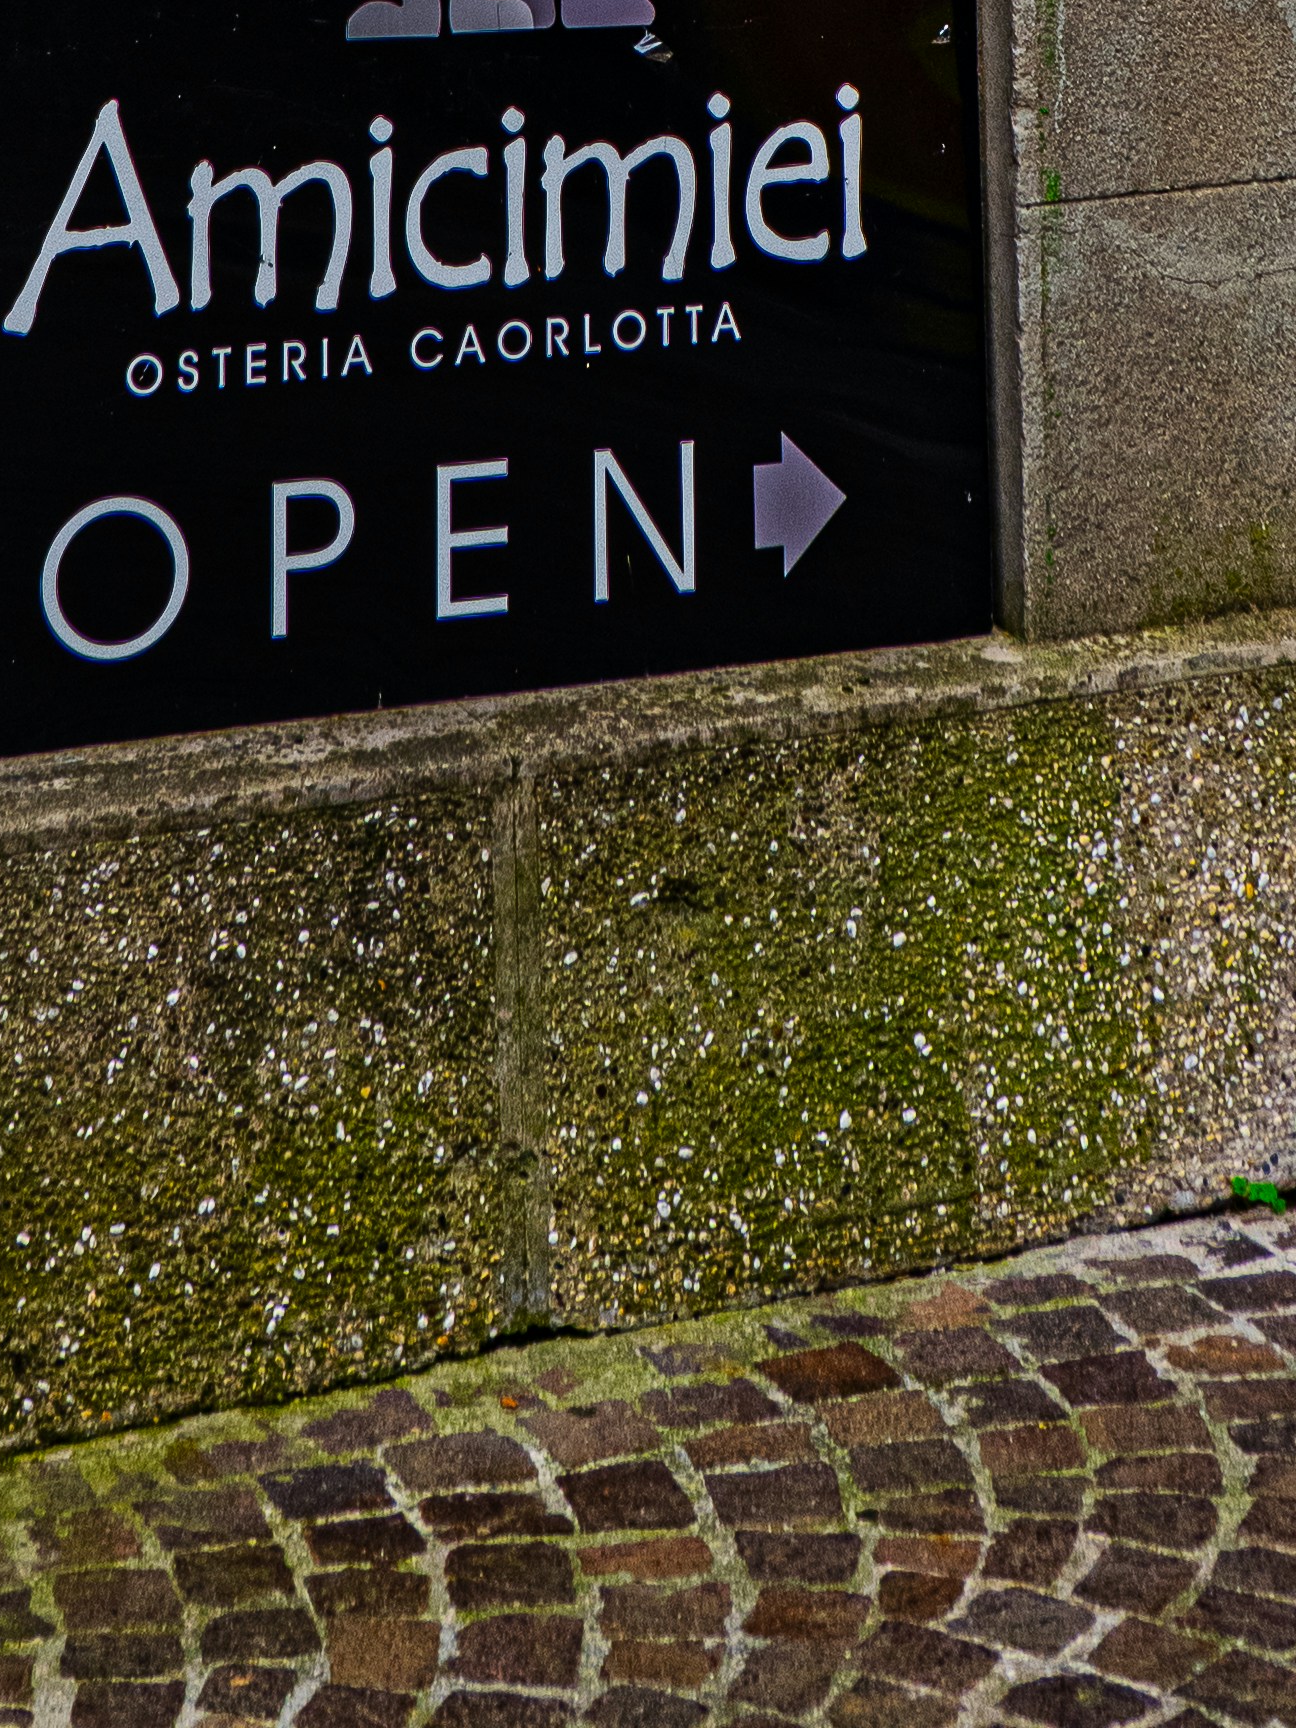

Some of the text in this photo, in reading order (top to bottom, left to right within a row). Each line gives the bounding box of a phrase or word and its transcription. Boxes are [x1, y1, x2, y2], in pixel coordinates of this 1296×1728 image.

[2, 83, 868, 335] Amicimiei
[125, 302, 743, 397] OSTERIA CAORLOTTA
[40, 440, 696, 662] OPEN
